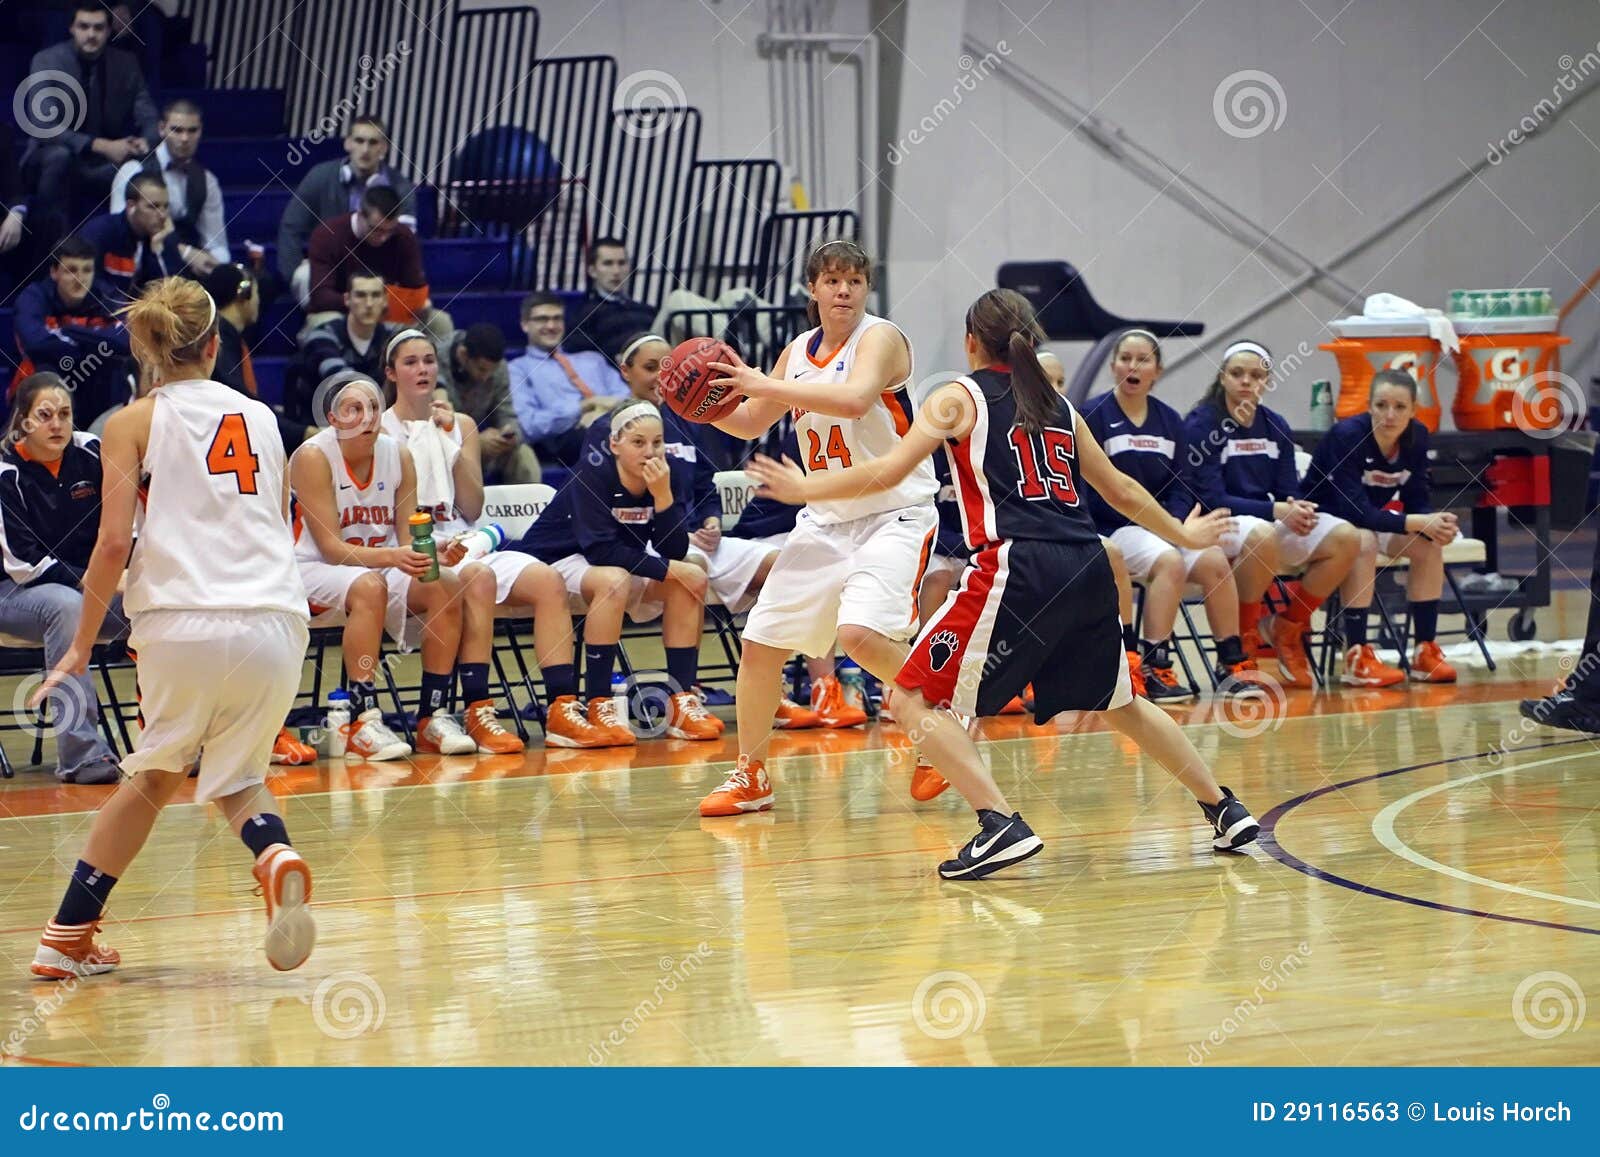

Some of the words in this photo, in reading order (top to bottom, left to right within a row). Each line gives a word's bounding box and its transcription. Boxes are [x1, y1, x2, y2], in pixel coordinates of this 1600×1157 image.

[1491, 349, 1520, 382] G
[205, 412, 260, 495] 4
[807, 424, 852, 472] 24
[1007, 423, 1079, 507] 15
[485, 502, 548, 518] CARROL
